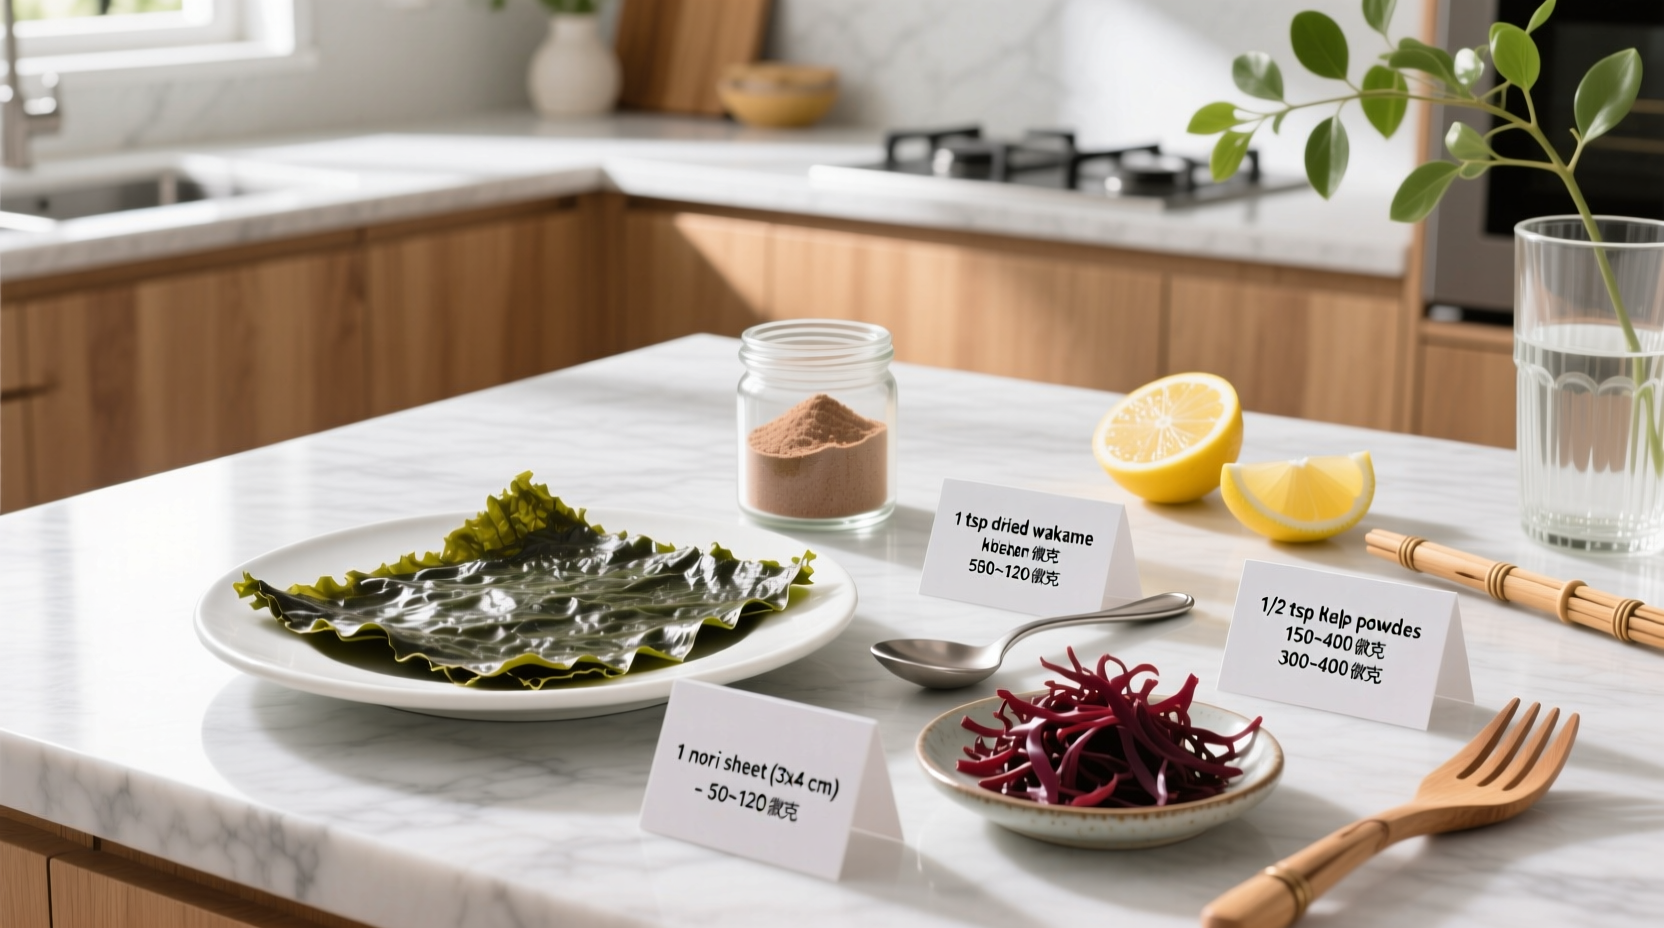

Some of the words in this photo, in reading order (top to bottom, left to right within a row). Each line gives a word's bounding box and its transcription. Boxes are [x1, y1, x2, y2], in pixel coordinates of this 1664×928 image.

[954, 510, 963, 526] 1
[965, 512, 989, 533] tsp
[991, 515, 1030, 536] dried
[1032, 525, 1094, 547] wakame
[1261, 596, 1287, 617] 1/2
[1289, 602, 1315, 625] tsp
[677, 743, 685, 761] 1
[688, 749, 722, 769] nori
[723, 754, 768, 780] sheet
[807, 777, 840, 802] cm)
